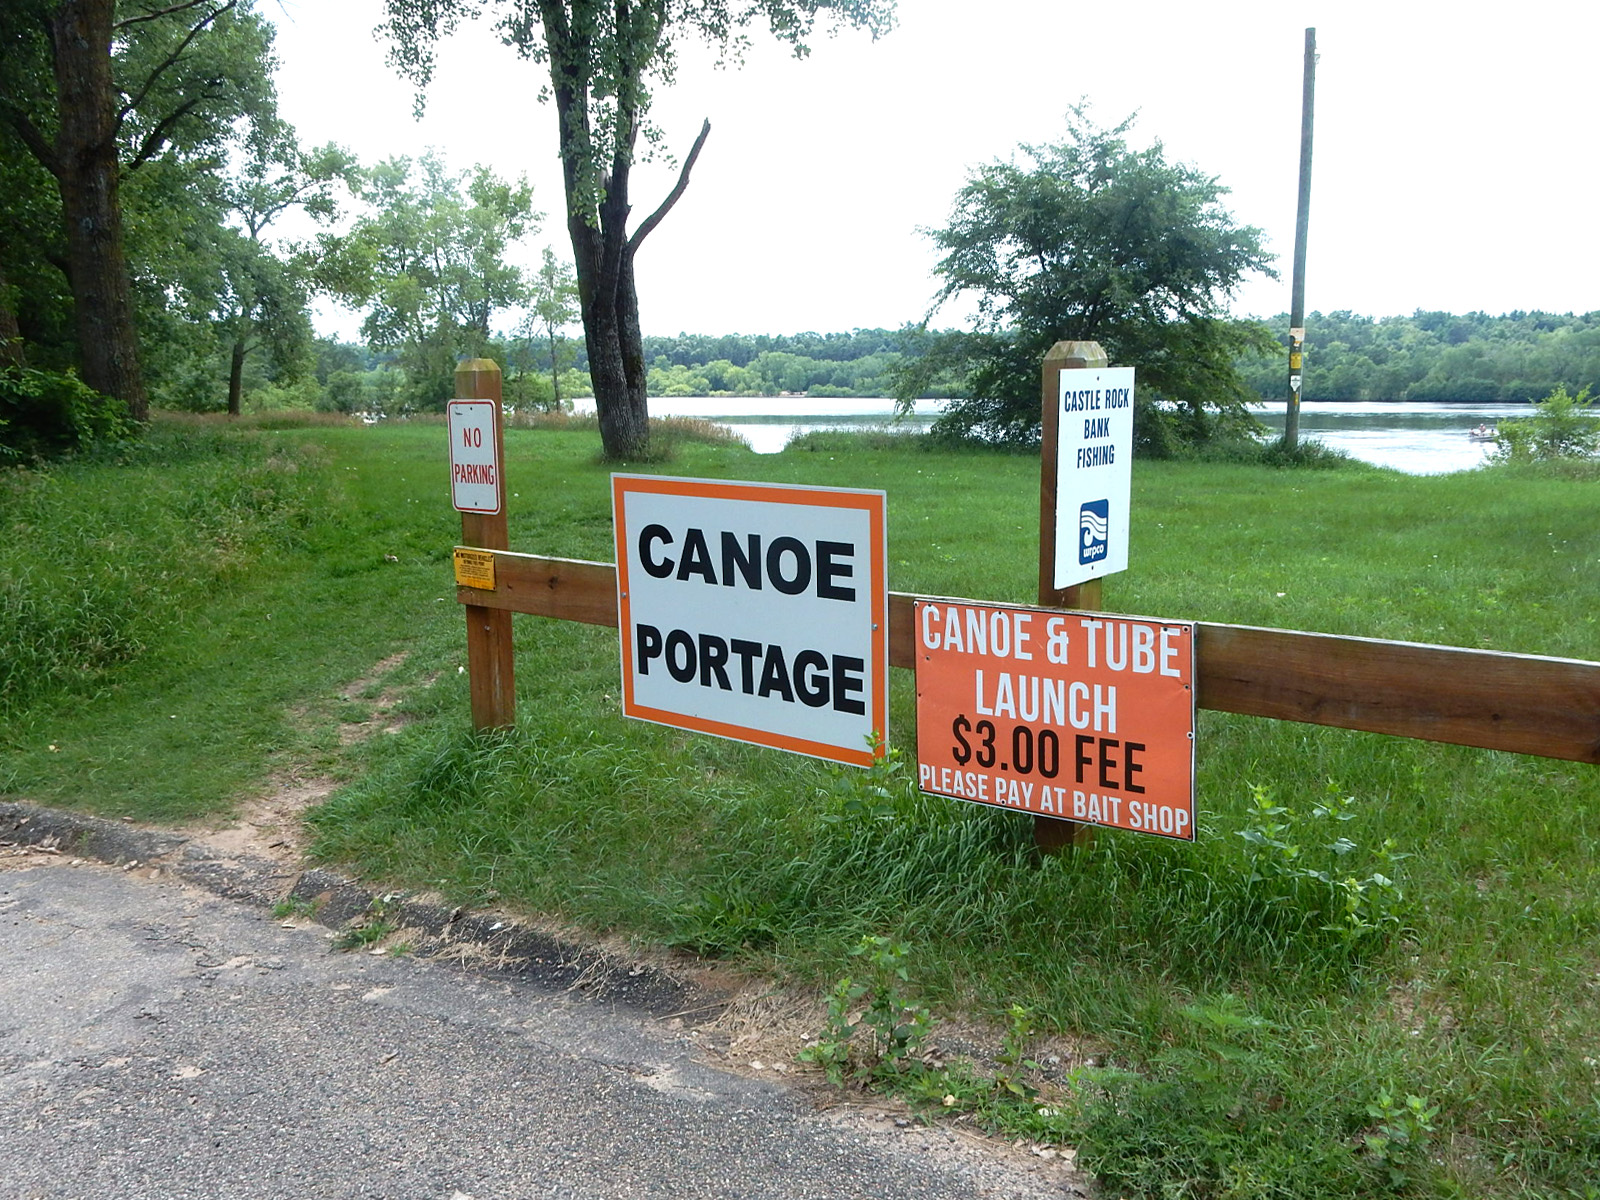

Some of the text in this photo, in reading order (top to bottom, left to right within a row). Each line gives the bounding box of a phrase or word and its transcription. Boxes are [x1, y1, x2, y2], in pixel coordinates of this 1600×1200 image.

[1064, 388, 1130, 412] CASTLE ROCK
[1084, 417, 1110, 440] BANK
[463, 427, 481, 448] NO
[1077, 444, 1115, 469] FISHING
[454, 464, 495, 485] PARKING
[638, 523, 856, 602] CANOE
[636, 623, 865, 716] PORTAGE
[921, 604, 1181, 678] CANOE & TUBE
[975, 669, 1116, 733] LAUNCH
[952, 714, 1146, 794] $3.00 FEE
[919, 763, 1189, 835] PLEASE PAY AT BAIT SHOP
